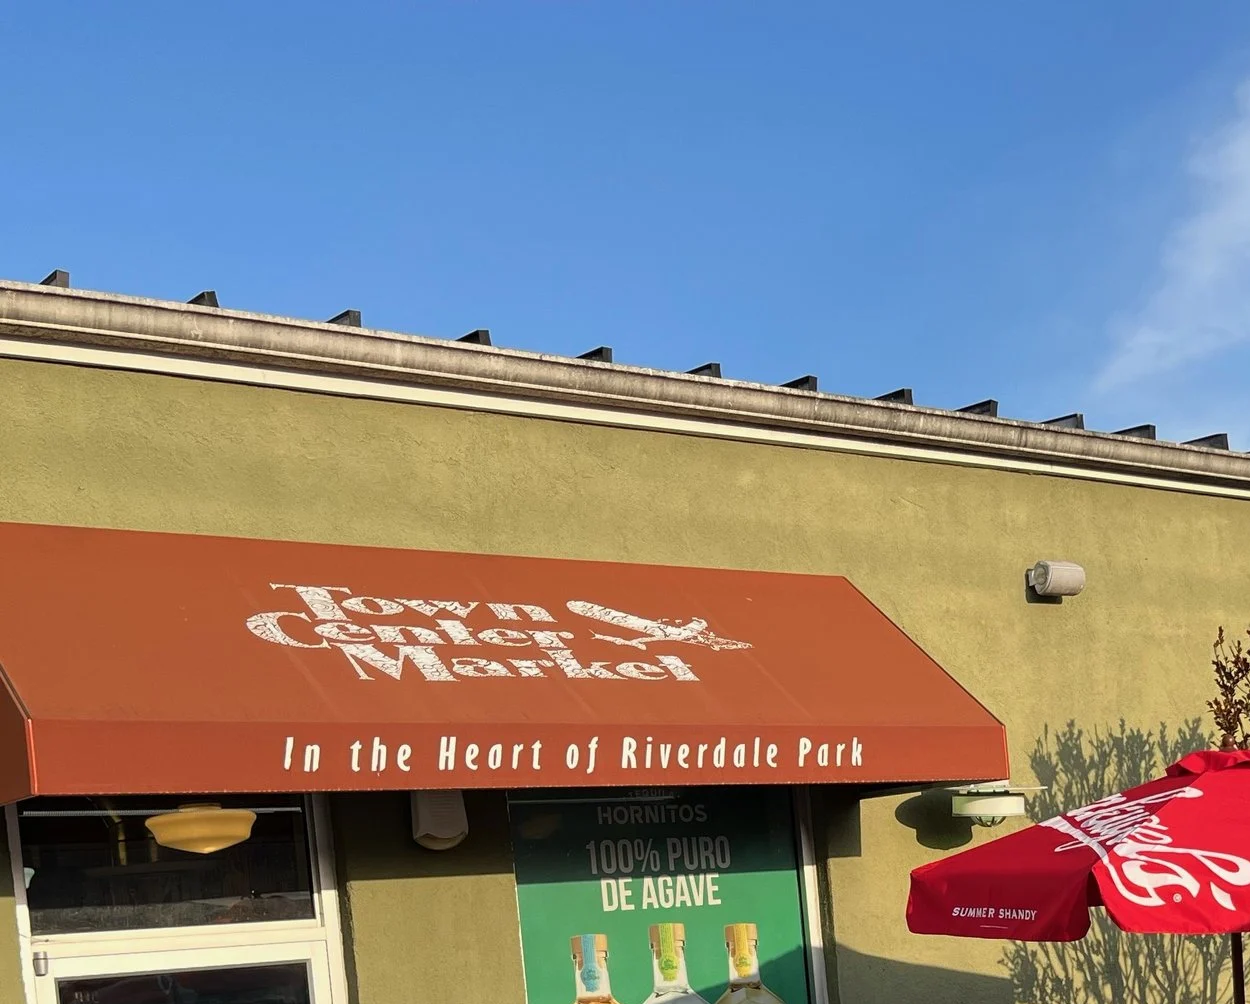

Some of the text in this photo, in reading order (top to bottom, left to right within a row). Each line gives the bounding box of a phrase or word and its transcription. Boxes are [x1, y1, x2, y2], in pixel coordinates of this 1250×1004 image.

[270, 582, 558, 622] Town
[246, 611, 575, 649] Center
[335, 643, 700, 682] Market
[284, 736, 863, 774] In the Heart of Riverdale Park
[598, 804, 707, 824] HORNITOS
[586, 835, 731, 874] 100% PURO
[600, 872, 721, 912] DE AGAVE
[952, 907, 1037, 920] SUMMER SHANDY
